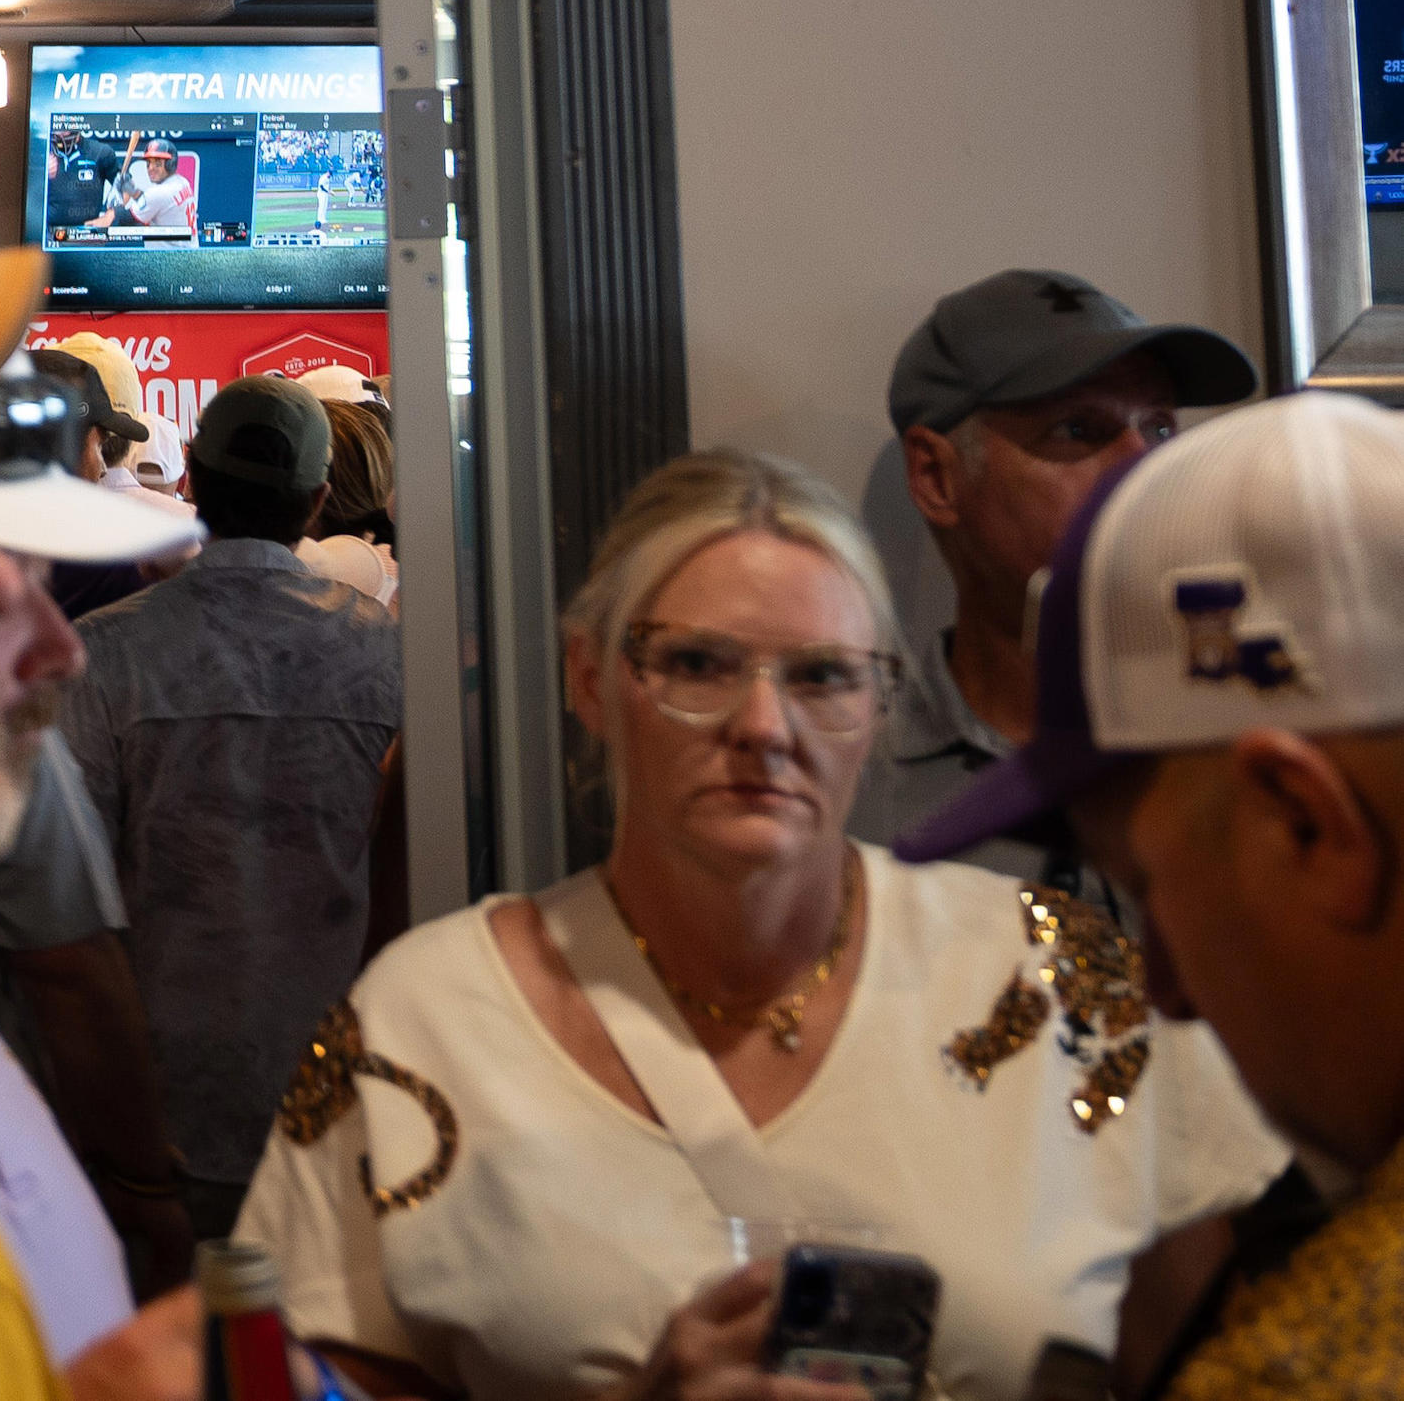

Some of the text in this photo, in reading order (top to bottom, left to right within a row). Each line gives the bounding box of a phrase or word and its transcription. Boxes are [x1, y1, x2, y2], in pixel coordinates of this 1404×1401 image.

[53, 72, 364, 100] MLB EXTRA INNINGS
[262, 114, 286, 122] Detroit
[262, 122, 284, 131] Tampa
[285, 122, 297, 130] Bay
